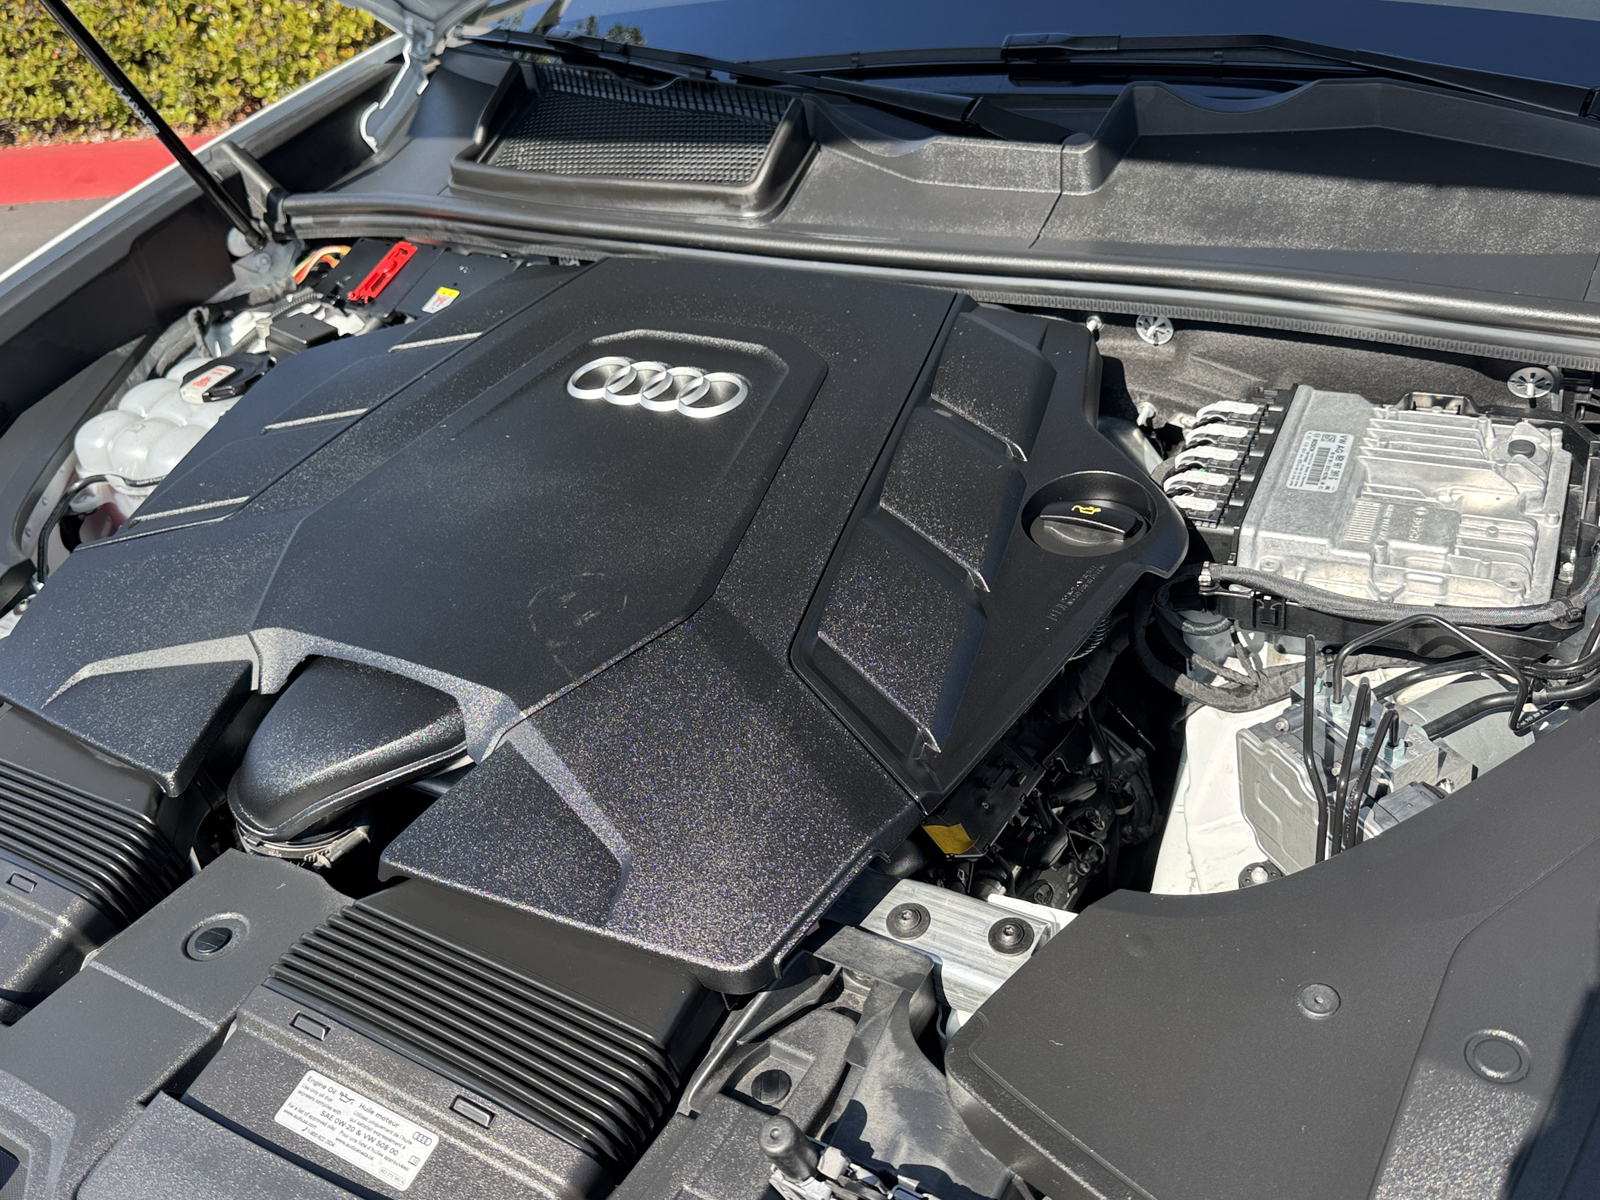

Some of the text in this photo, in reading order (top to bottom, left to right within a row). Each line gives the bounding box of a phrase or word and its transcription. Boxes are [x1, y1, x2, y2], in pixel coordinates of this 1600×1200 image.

[306, 1075, 337, 1094] Engine Oil
[358, 1102, 399, 1127] Huile moteur
[320, 1110, 334, 1121] SAE
[363, 1133, 376, 1143] VW
[375, 1140, 389, 1150] 508
[389, 1147, 399, 1156] 00
